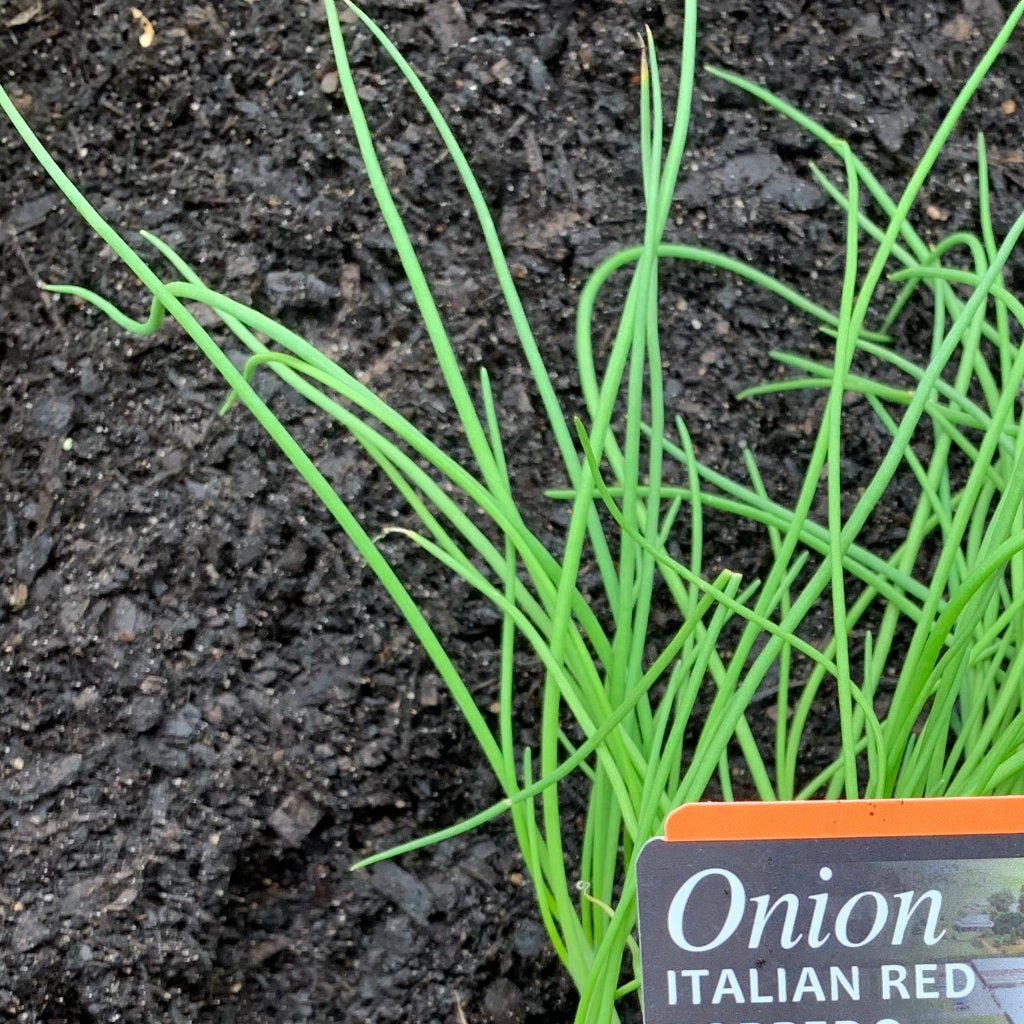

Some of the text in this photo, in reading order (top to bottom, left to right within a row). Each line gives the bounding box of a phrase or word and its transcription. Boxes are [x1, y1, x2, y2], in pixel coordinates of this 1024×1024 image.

[667, 866, 946, 952] Onion
[667, 962, 976, 1005] ITALIAN RED
